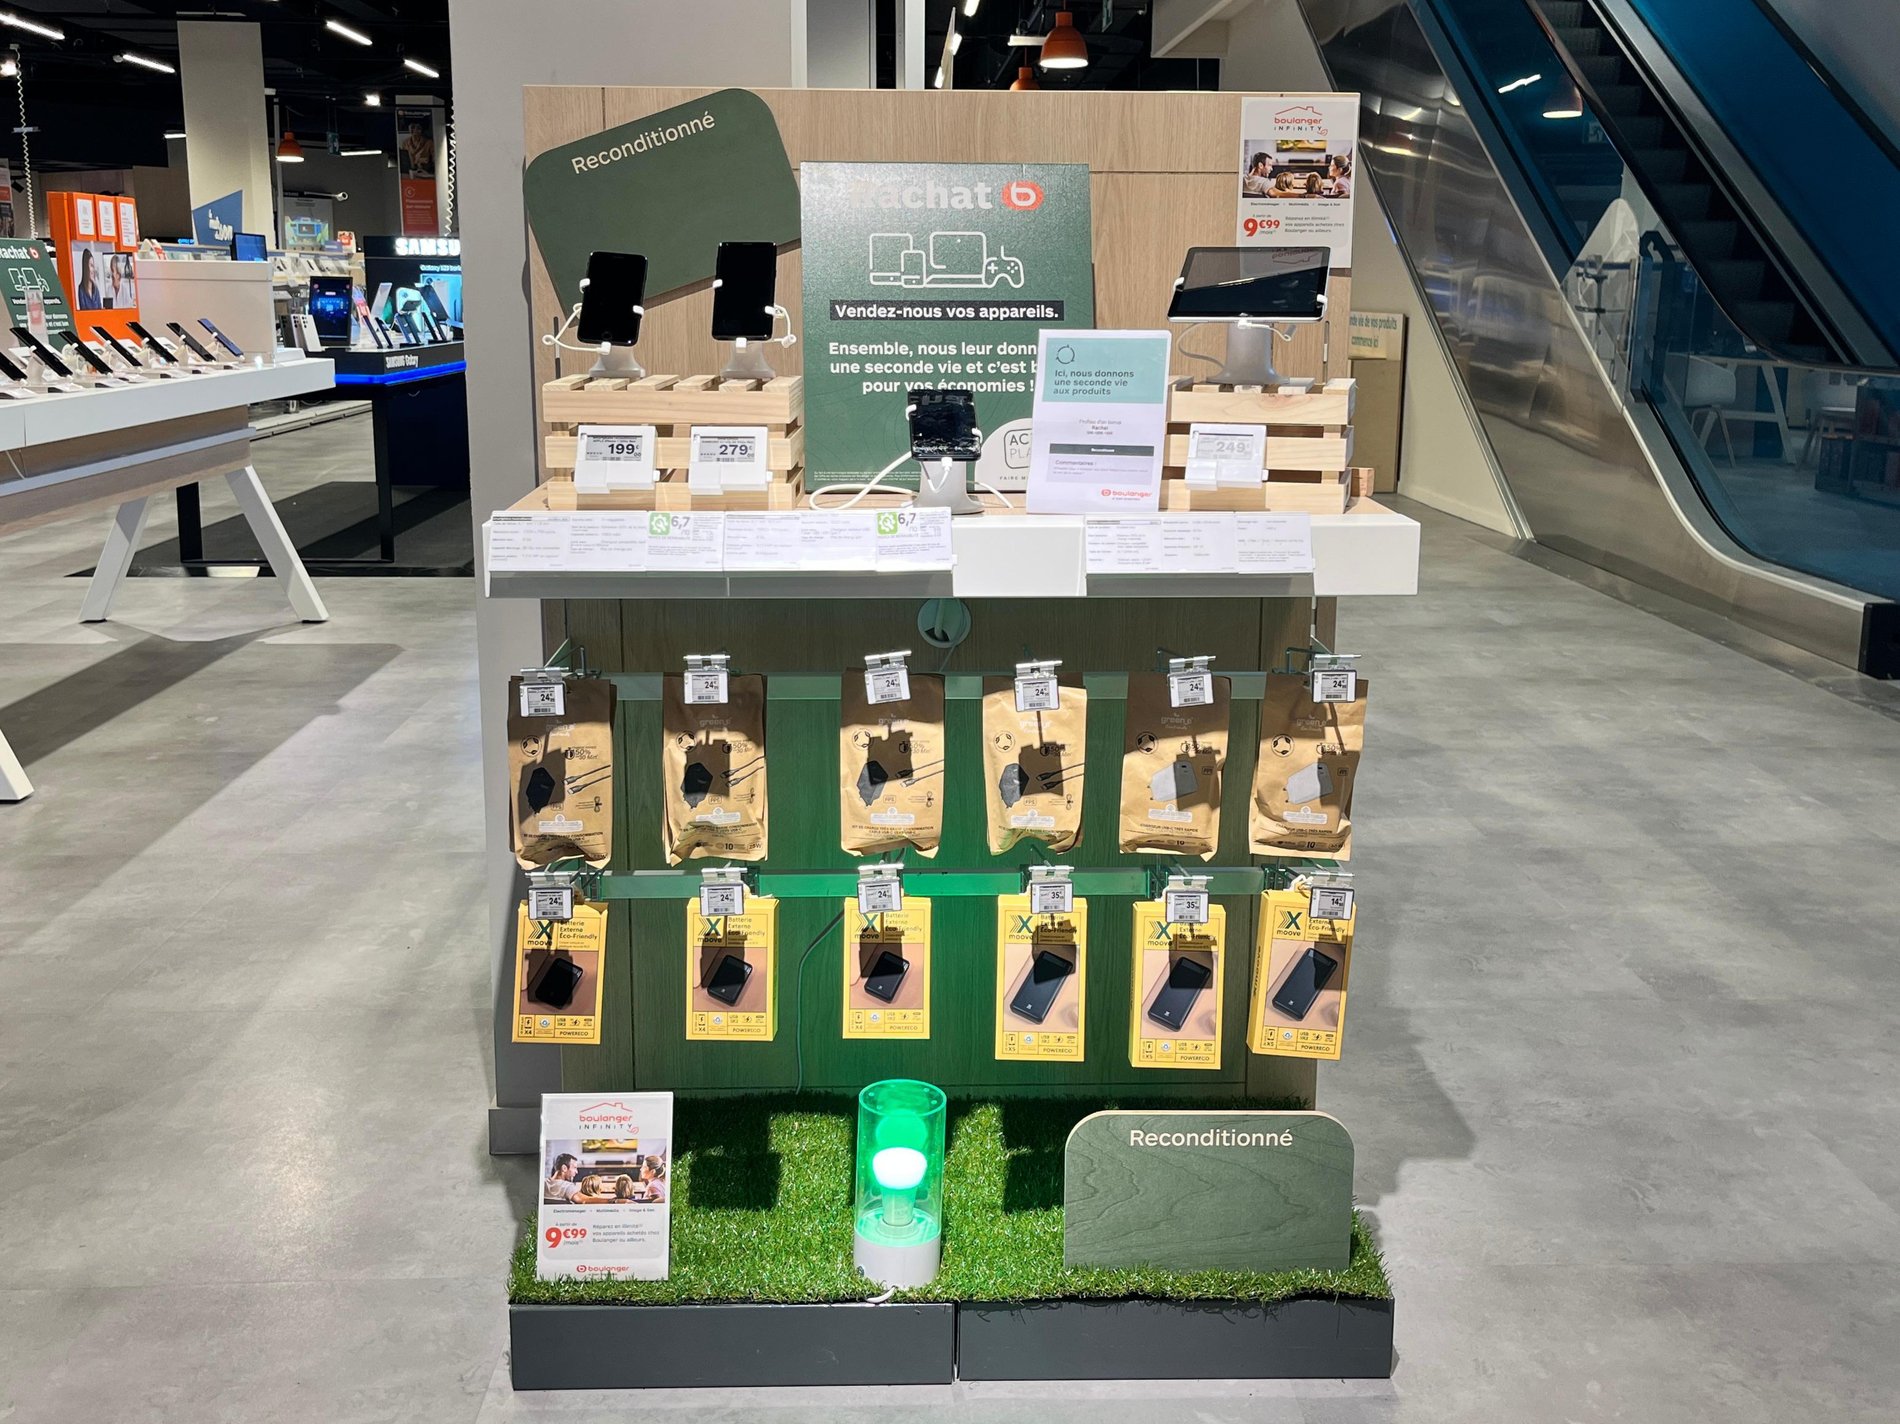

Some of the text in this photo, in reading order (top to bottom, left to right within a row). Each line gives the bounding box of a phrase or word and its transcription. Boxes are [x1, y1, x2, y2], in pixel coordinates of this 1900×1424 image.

[1274, 117, 1323, 125] boulanger
[571, 110, 716, 175] Reconditionné
[394, 237, 461, 257] SAMSU
[834, 304, 1059, 321] Vendez-nous vos appareils.
[828, 342, 1038, 358] Ensemble, nous leur donn
[830, 363, 861, 374] une
[864, 360, 934, 374] seconde
[937, 360, 963, 374] vie
[966, 361, 982, 374] et
[1054, 369, 1068, 378] Ici,
[1094, 370, 1135, 378] donnons
[862, 379, 1035, 395] pour vos économies !
[1073, 379, 1112, 387] seconde
[1114, 379, 1128, 387] vie
[1071, 388, 1111, 396] produits
[1009, 433, 1031, 446] AC
[1112, 489, 1152, 498] boulanger
[671, 515, 691, 530] 6,7
[897, 512, 917, 527] 6,7
[579, 1114, 633, 1123] boulanger
[1130, 1128, 1293, 1147] Reconditionné
[588, 1265, 629, 1273] boulanger
